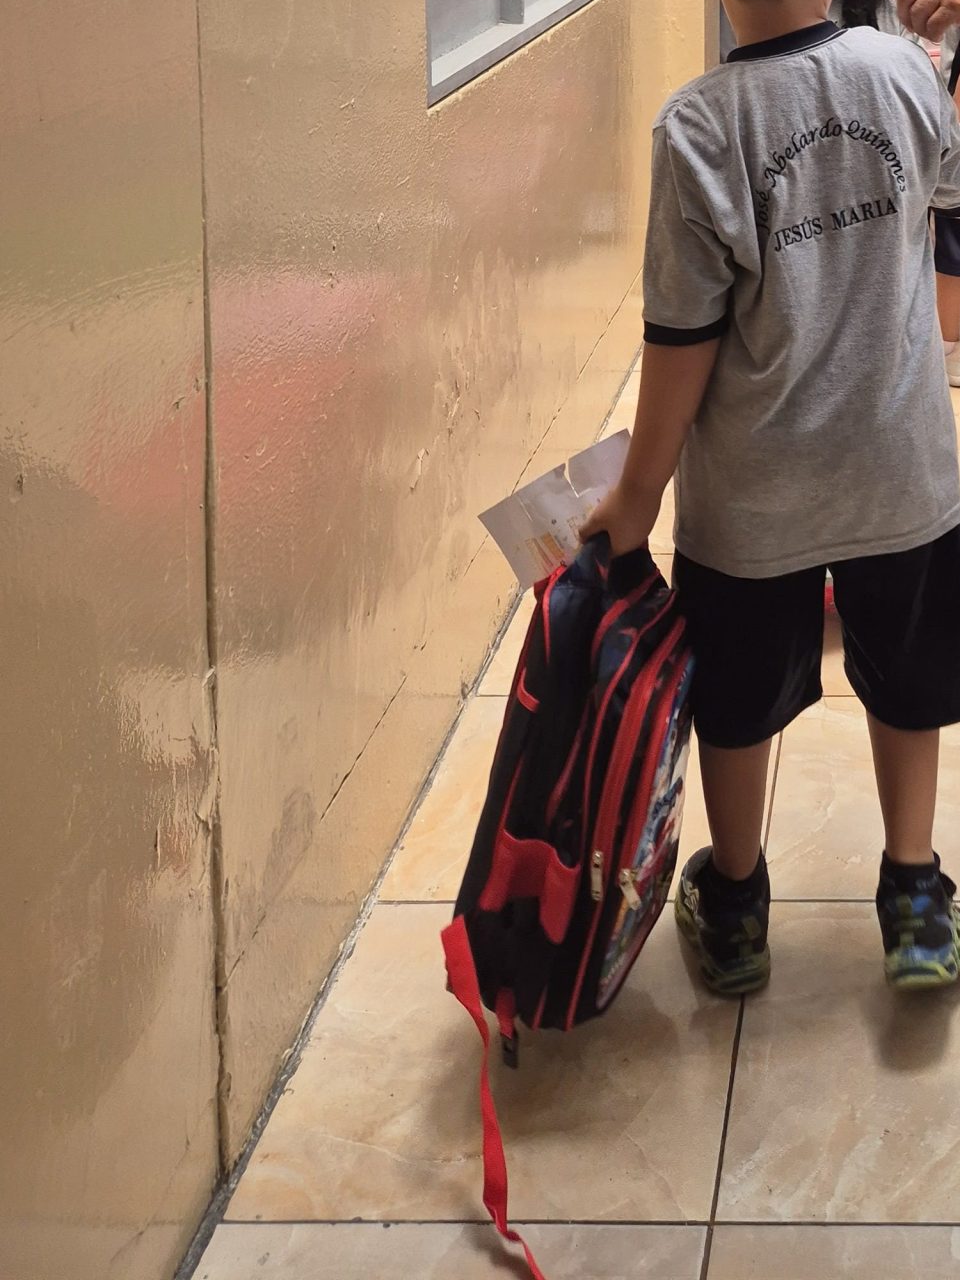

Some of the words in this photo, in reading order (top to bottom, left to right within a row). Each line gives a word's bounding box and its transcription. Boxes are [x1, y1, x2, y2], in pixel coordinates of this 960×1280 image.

[764, 117, 843, 188] Abelardo
[845, 120, 906, 193] Quiñones
[774, 216, 824, 252] JESÚS
[830, 197, 898, 231] MARIA
